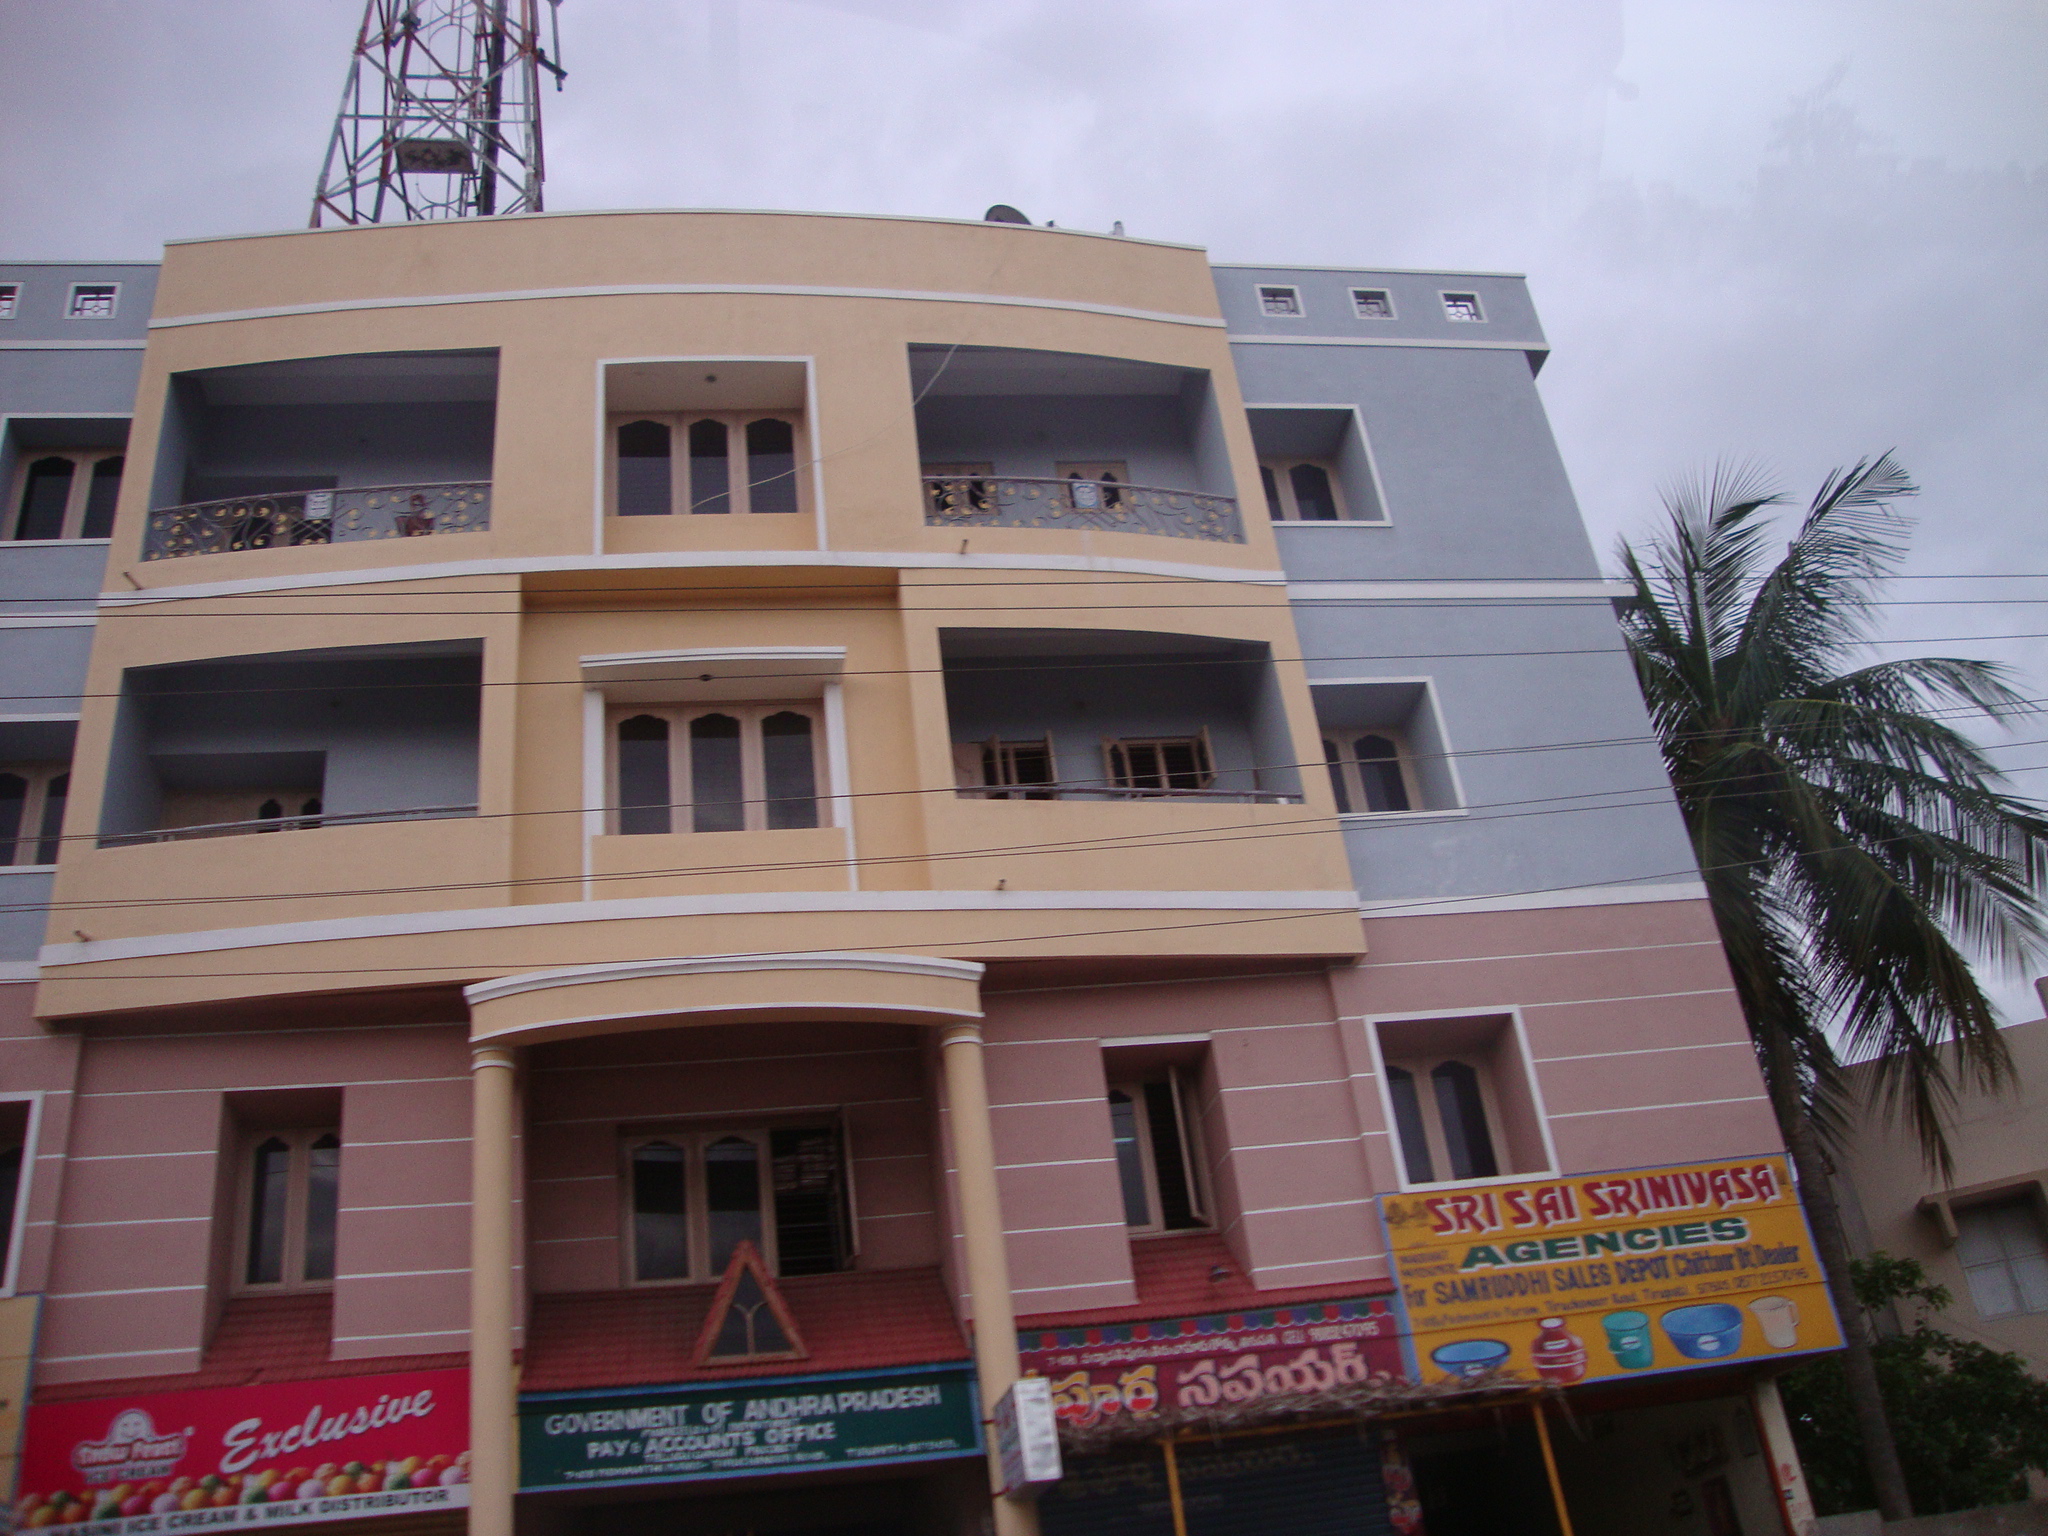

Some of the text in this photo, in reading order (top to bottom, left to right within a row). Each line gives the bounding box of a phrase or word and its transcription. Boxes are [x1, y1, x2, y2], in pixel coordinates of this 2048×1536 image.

[1425, 1164, 1781, 1235] SRI SAI SRINIVASA
[1458, 1217, 1750, 1272] AGENCIES
[1552, 1262, 1611, 1291] SALES
[1615, 1255, 1669, 1284] DEPOT
[219, 1389, 436, 1473] Exclusive
[544, 1405, 690, 1435] GOVERNMENT
[701, 1400, 735, 1429] OF
[743, 1394, 837, 1419] ANDHRA
[837, 1384, 942, 1413] PRADESH
[587, 1438, 631, 1459] PAY
[644, 1430, 756, 1454] ACCOUNTS
[764, 1420, 837, 1444] OFFICE
[127, 1517, 159, 1533] ICE
[167, 1509, 236, 1528] CREAM
[244, 1507, 257, 1521] &
[264, 1502, 311, 1519] MILK
[319, 1489, 449, 1514] DISTRIBUTOR
